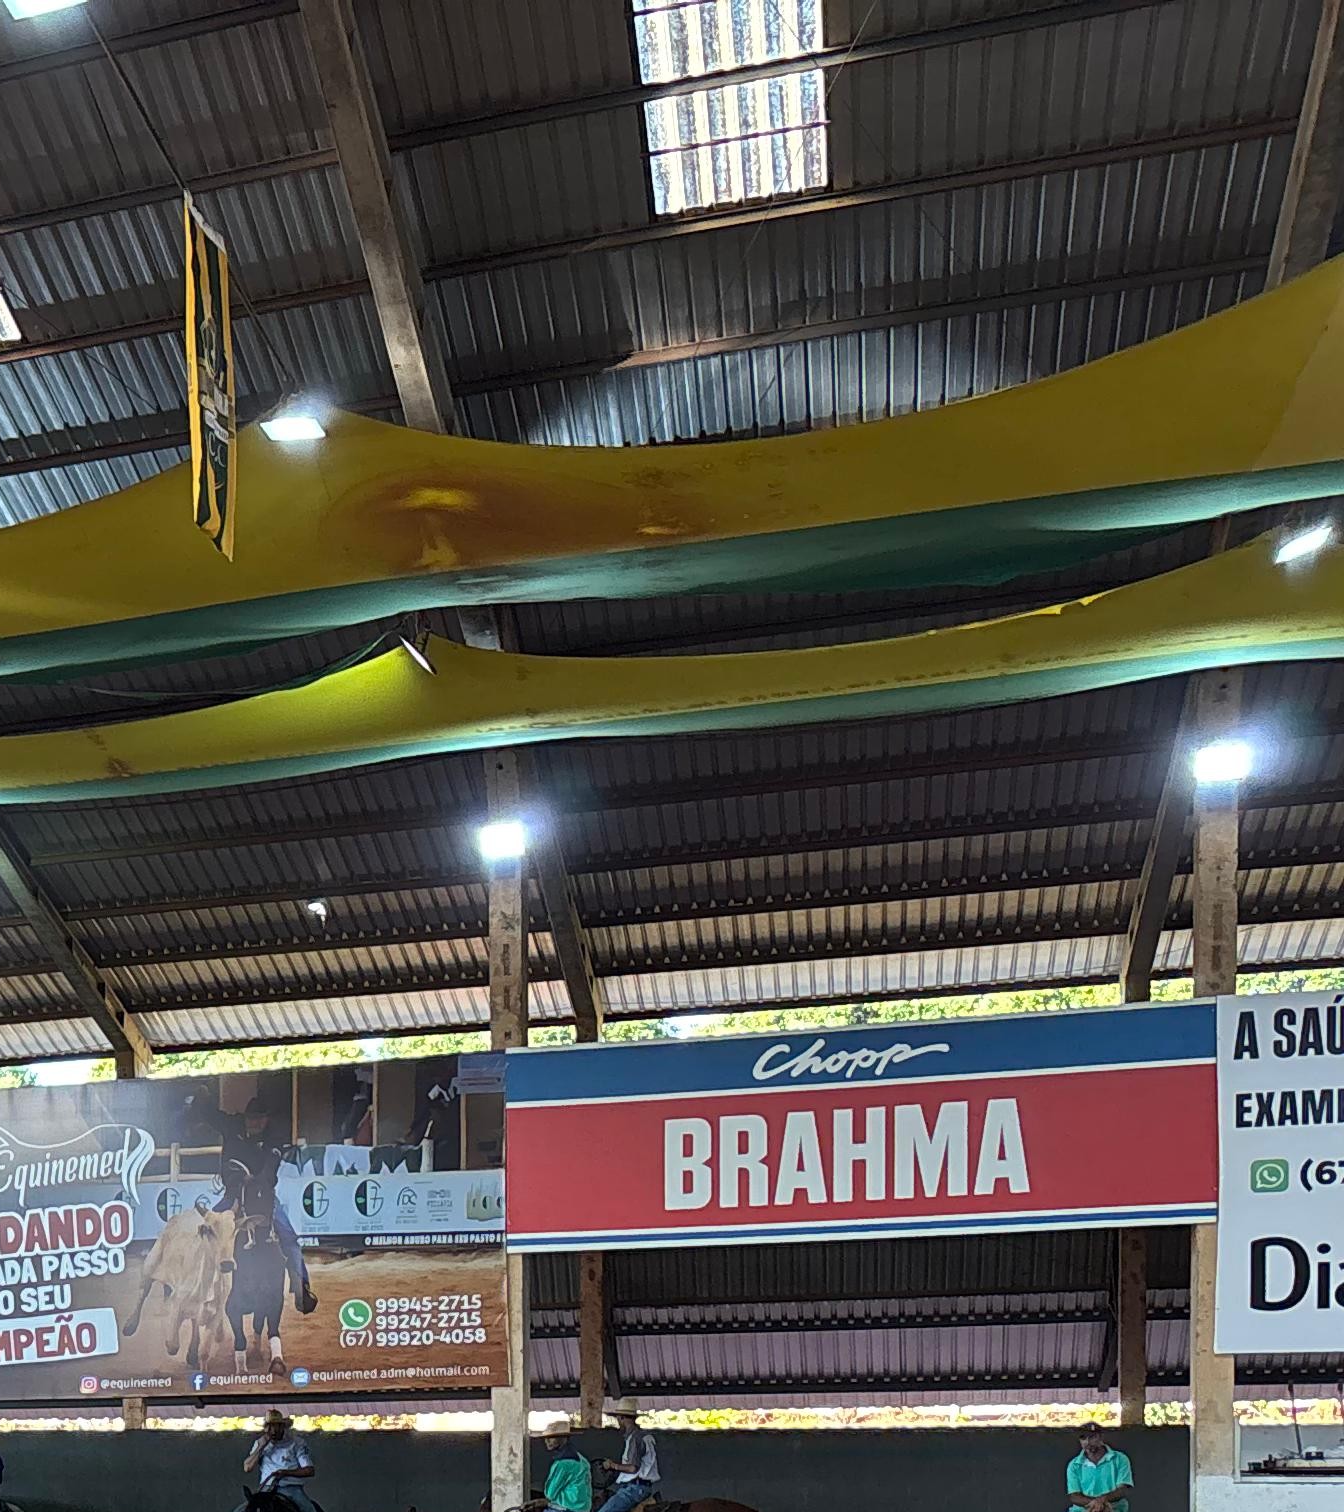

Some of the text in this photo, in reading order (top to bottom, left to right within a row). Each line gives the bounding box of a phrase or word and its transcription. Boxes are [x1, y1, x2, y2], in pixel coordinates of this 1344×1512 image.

[1233, 1010, 1259, 1060] A
[753, 1039, 950, 1081] Chopp
[664, 1098, 1031, 1211] BRAHMA
[42, 1248, 125, 1283] PASSO
[20, 1283, 72, 1314] SEU
[375, 1294, 482, 1313] 99945-2715
[375, 1311, 482, 1330] 99247-2715
[339, 1328, 487, 1348] (67) 99920-4058
[100, 1375, 172, 1390] @equinemed
[209, 1372, 273, 1387] equinemed
[312, 1364, 490, 1383] equinemed.adm@hotmail.com
